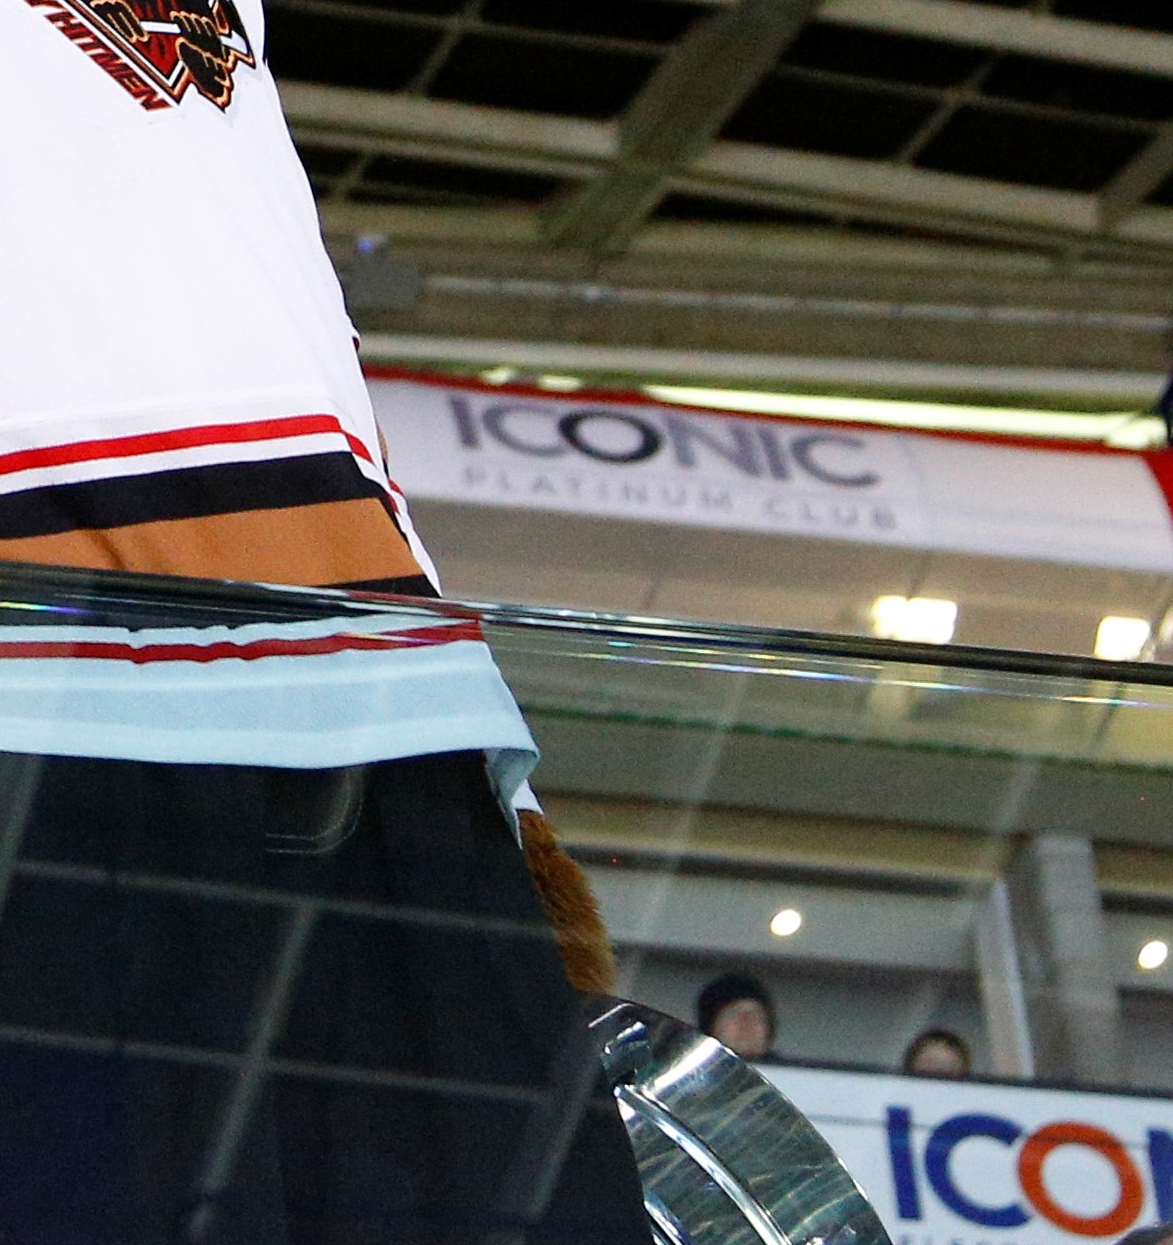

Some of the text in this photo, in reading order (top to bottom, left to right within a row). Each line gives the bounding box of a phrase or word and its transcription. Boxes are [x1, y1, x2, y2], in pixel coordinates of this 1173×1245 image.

[43, 11, 173, 112] HITMEN
[448, 394, 883, 488] ICONIC
[462, 466, 897, 531] PLATINUM CLUB
[885, 1105, 1173, 1239] ICO
